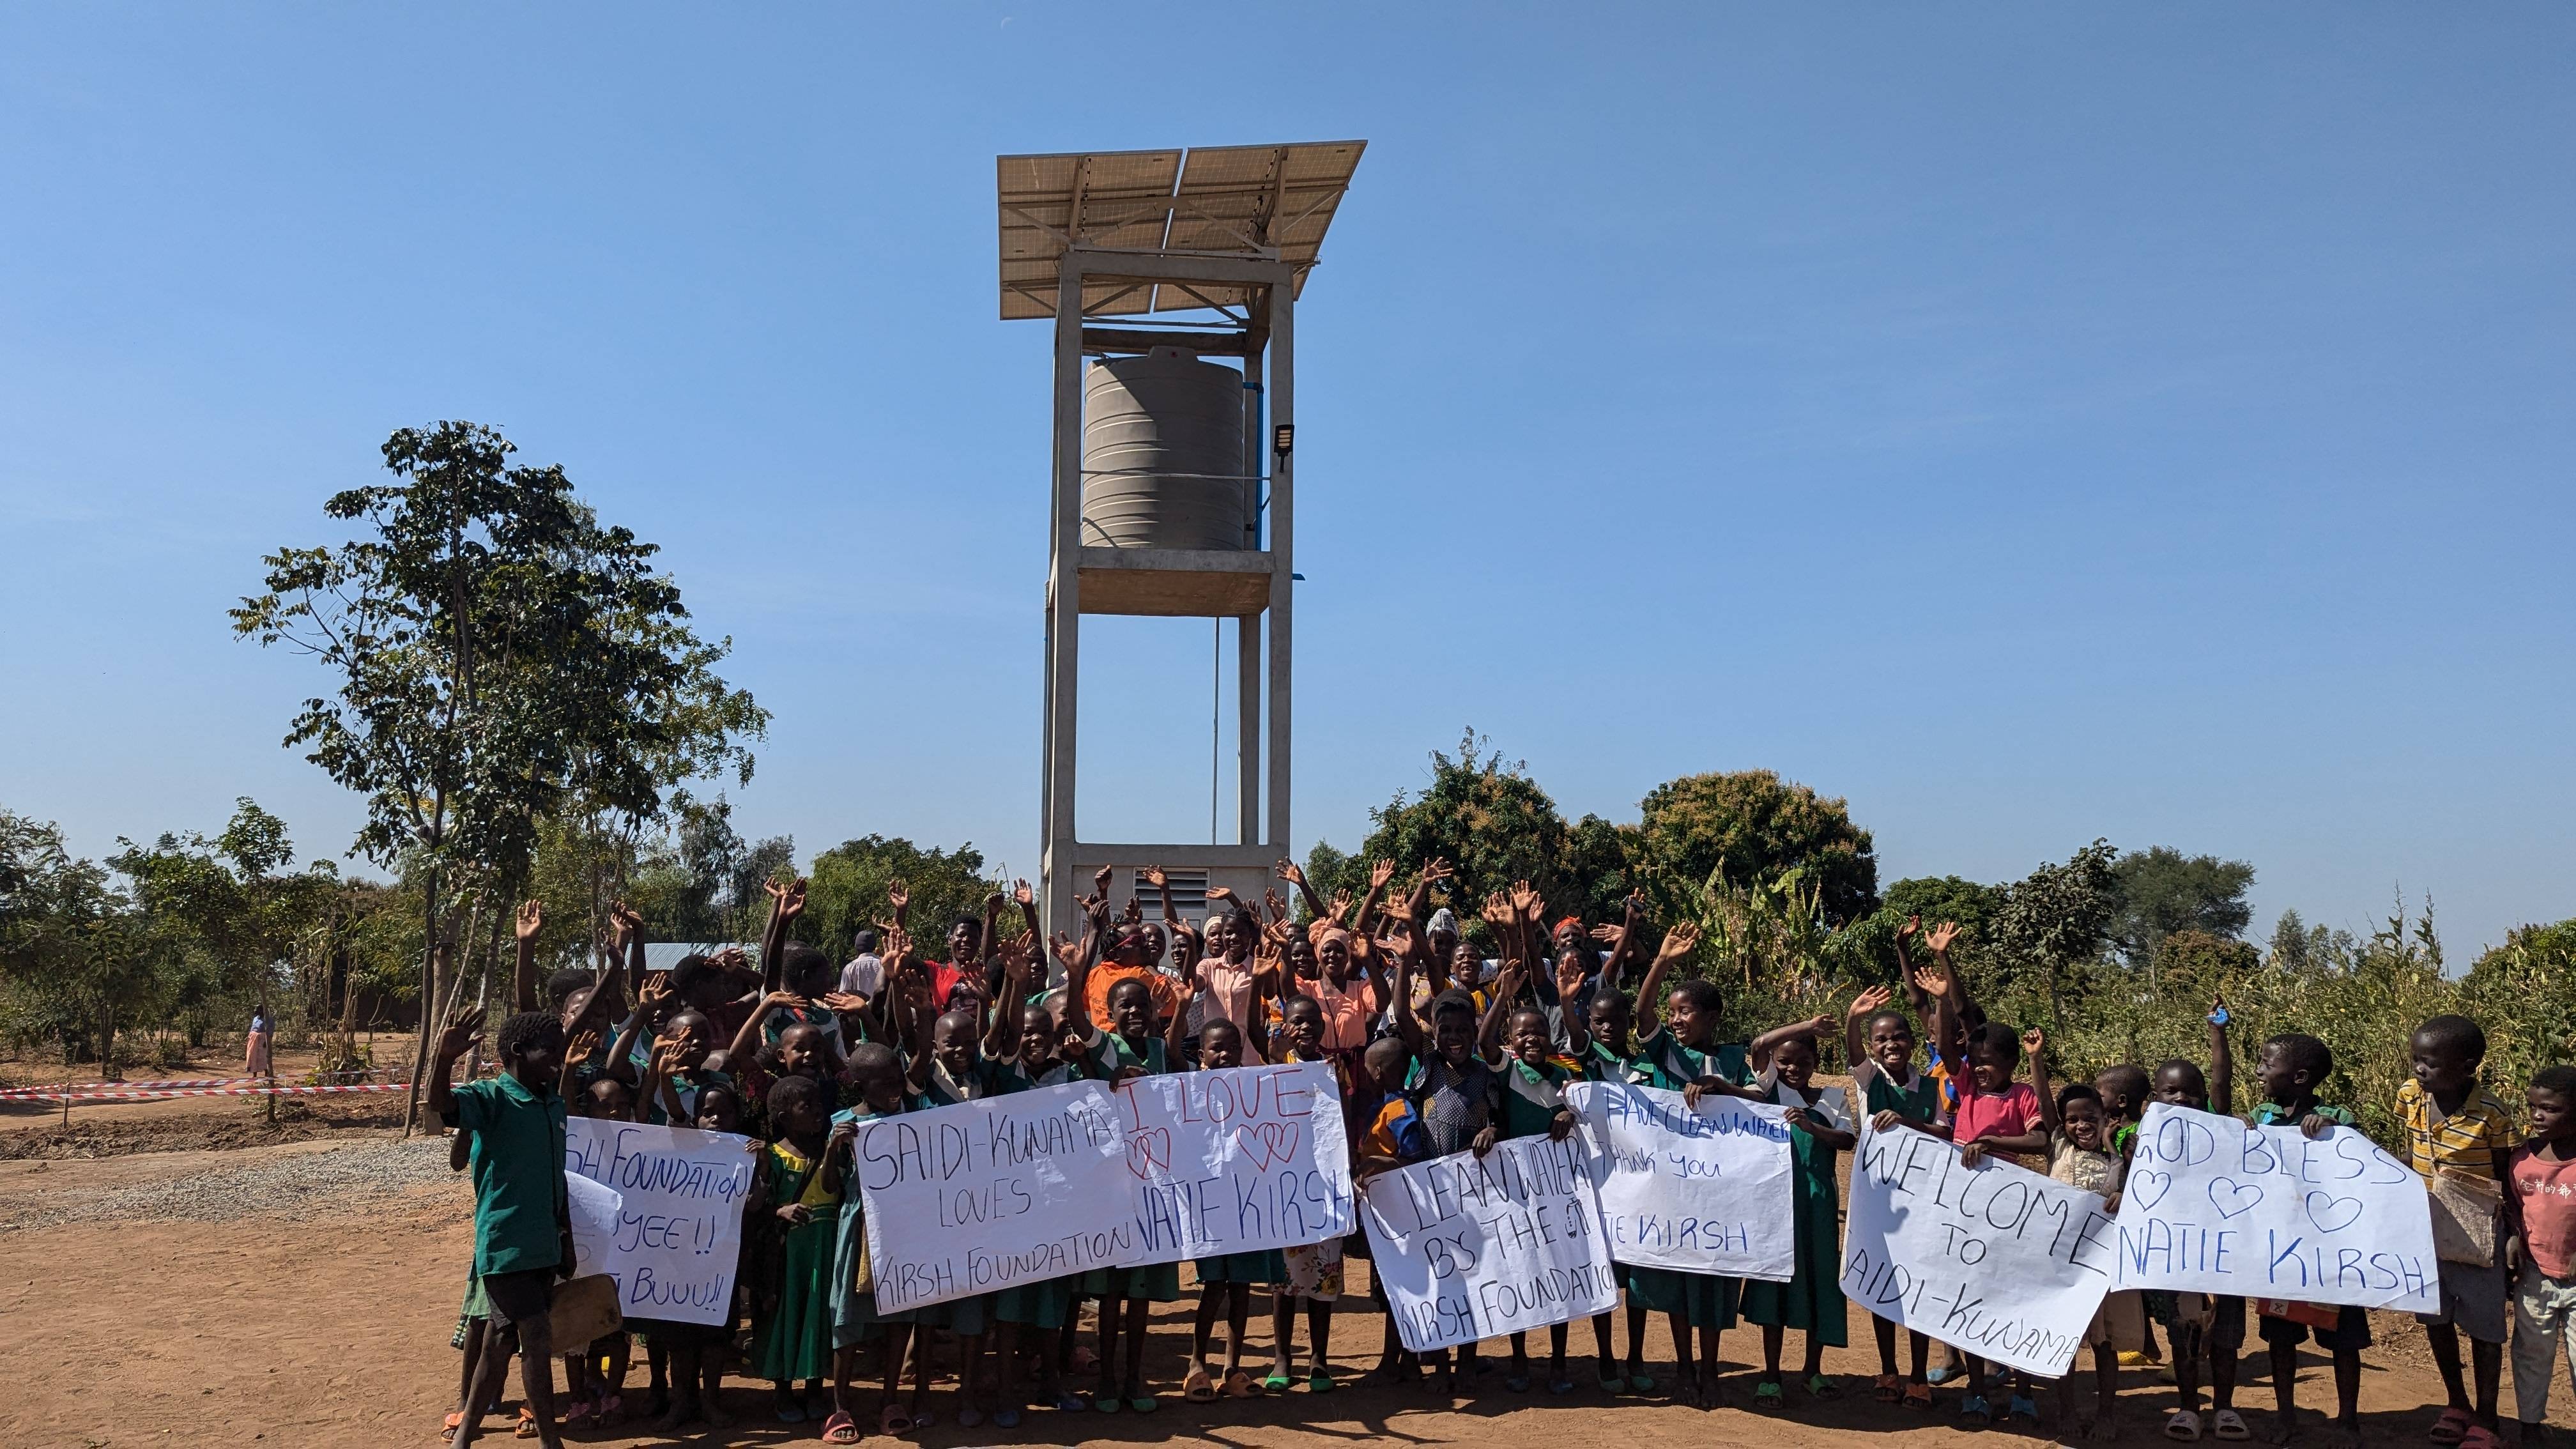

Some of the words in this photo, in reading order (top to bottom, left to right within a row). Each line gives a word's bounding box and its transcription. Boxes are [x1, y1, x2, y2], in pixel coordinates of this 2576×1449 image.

[1117, 1080, 1149, 1134] I
[1179, 1068, 1313, 1123] LOVE
[1606, 1087, 1664, 1130] HAVE
[1664, 1104, 1728, 1137] CLEAN
[1734, 1112, 1790, 1140] WATER
[608, 1128, 749, 1203] FOUNDATION
[862, 1108, 1115, 1191] SAIDI-KUNAMA
[1593, 1140, 1657, 1178] THANK
[1669, 1152, 1722, 1178] YOU
[2242, 1128, 2407, 1185] BLESS
[939, 1177, 1032, 1227] LOVES
[1234, 1169, 1351, 1239] KIRSH
[1366, 1150, 1510, 1241] CLEAN
[1508, 1135, 1590, 1200] WATER
[1862, 1129, 2115, 1276] WELCOME
[870, 1254, 954, 1311] KIRSH
[968, 1221, 1131, 1286] FOUNDATION
[1424, 1230, 1476, 1280] BY
[1479, 1205, 1557, 1259] THE
[1639, 1215, 1748, 1254] KIRSH
[1941, 1223, 1987, 1265] TO
[2119, 1218, 2237, 1284] NATIE
[2268, 1229, 2425, 1298] KIRSH
[1392, 1294, 1477, 1349] KIRSH
